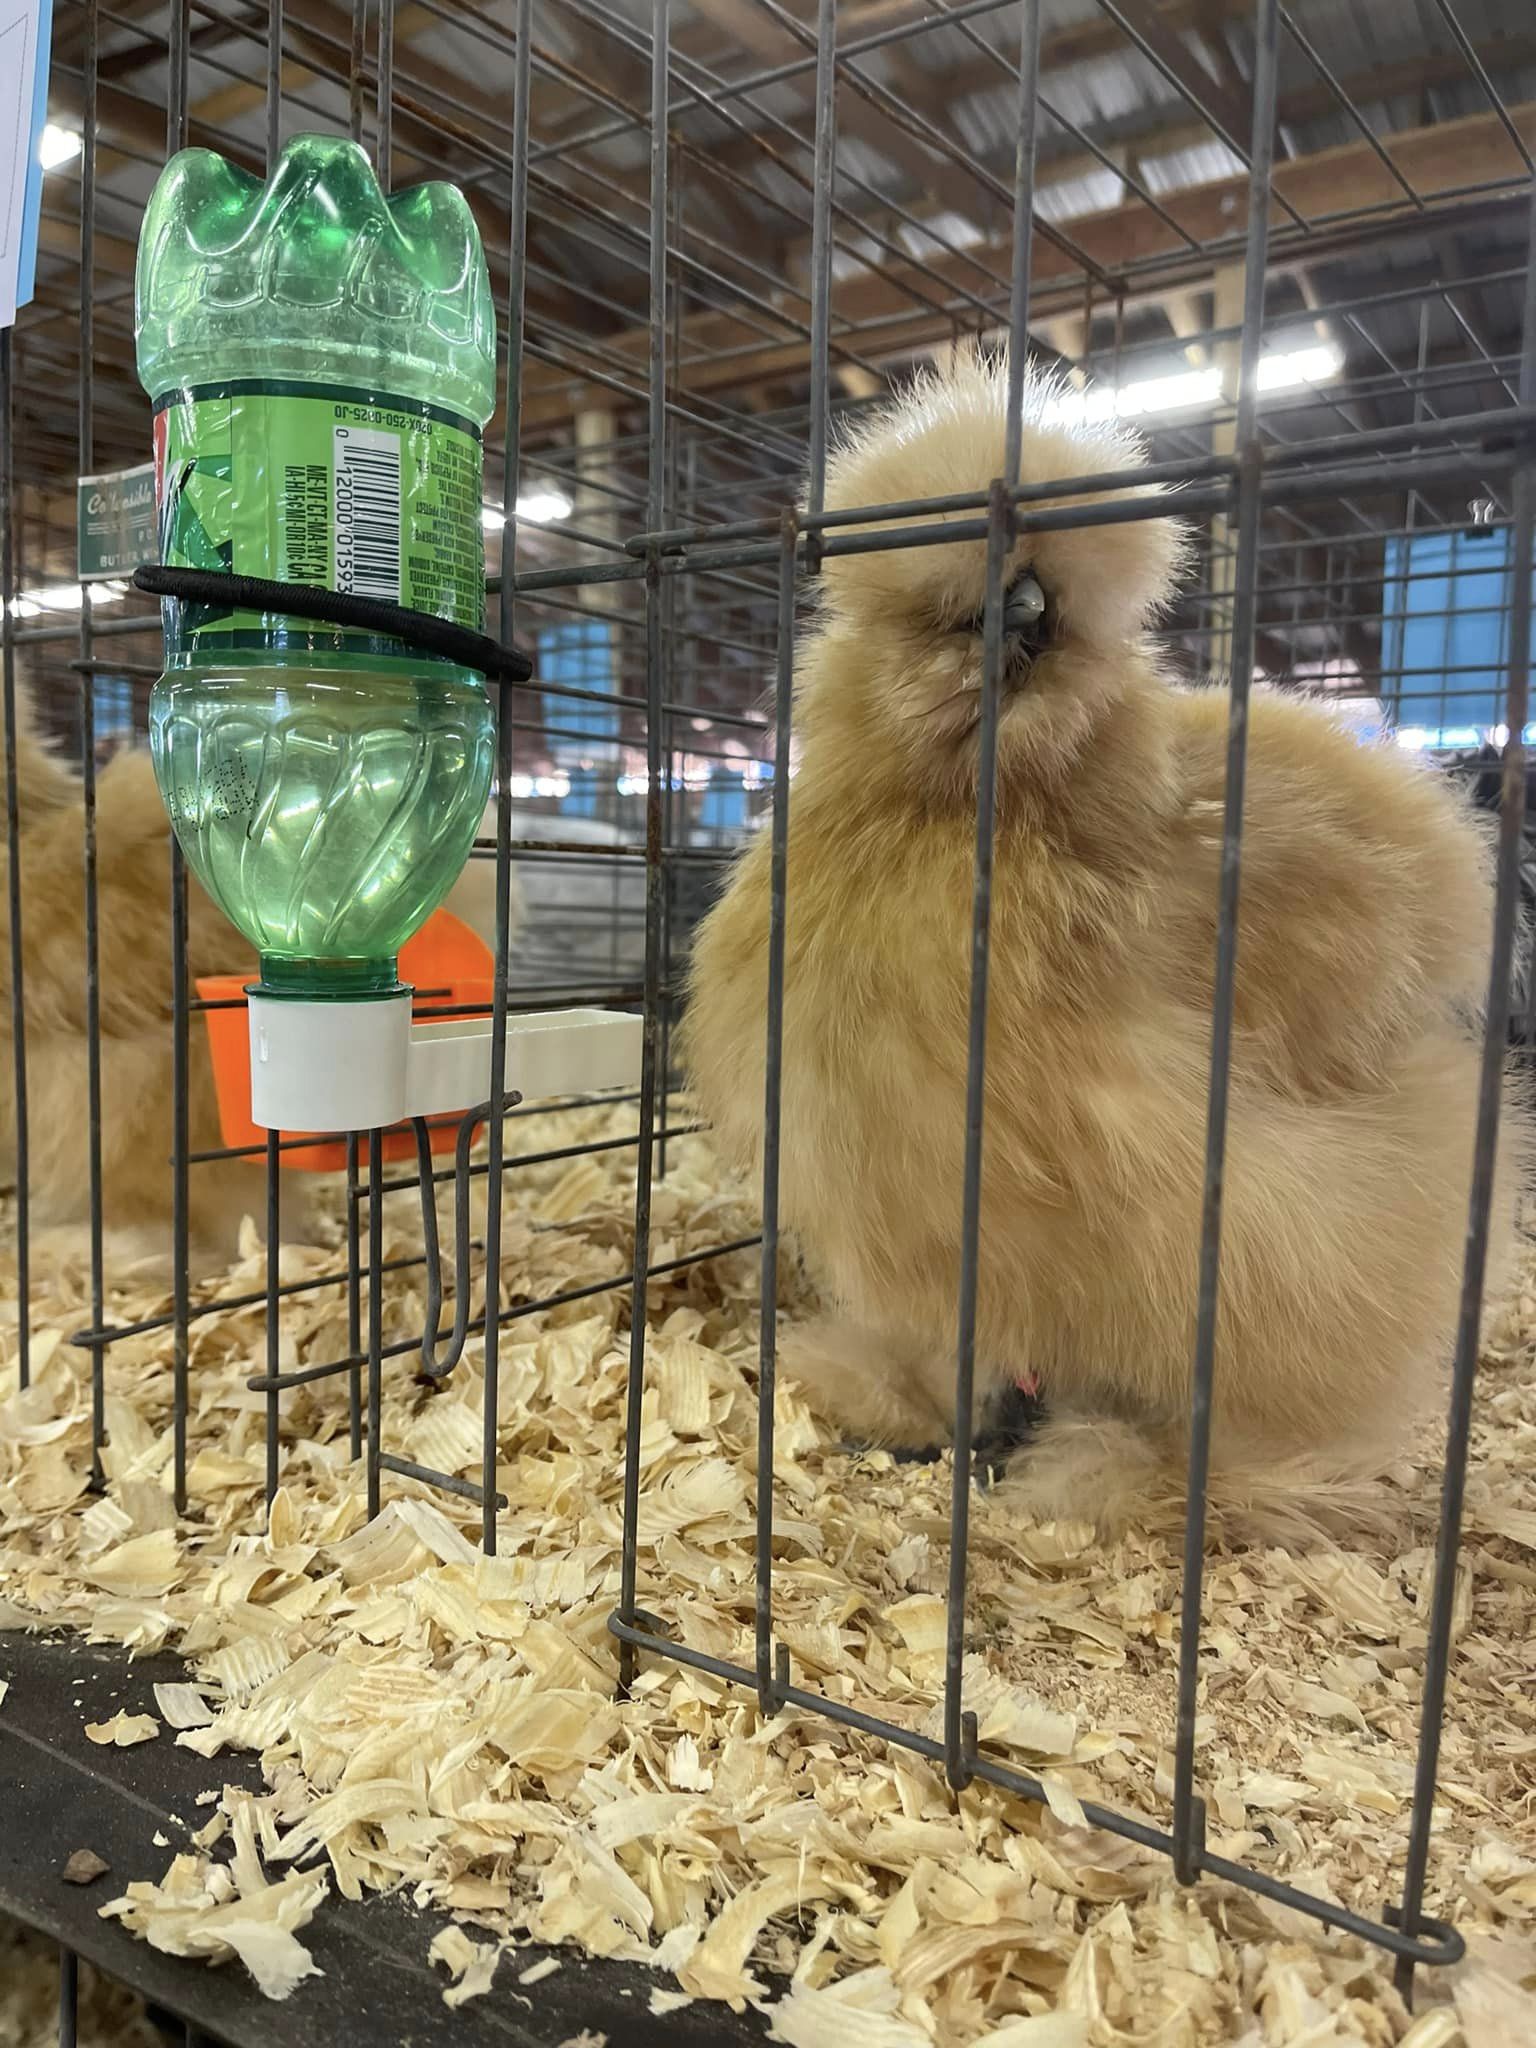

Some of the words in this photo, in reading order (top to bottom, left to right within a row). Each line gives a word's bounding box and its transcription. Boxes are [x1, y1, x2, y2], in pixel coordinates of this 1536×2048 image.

[336, 428, 349, 439] 0
[336, 466, 353, 525] 12000
[336, 534, 353, 594] 01593
